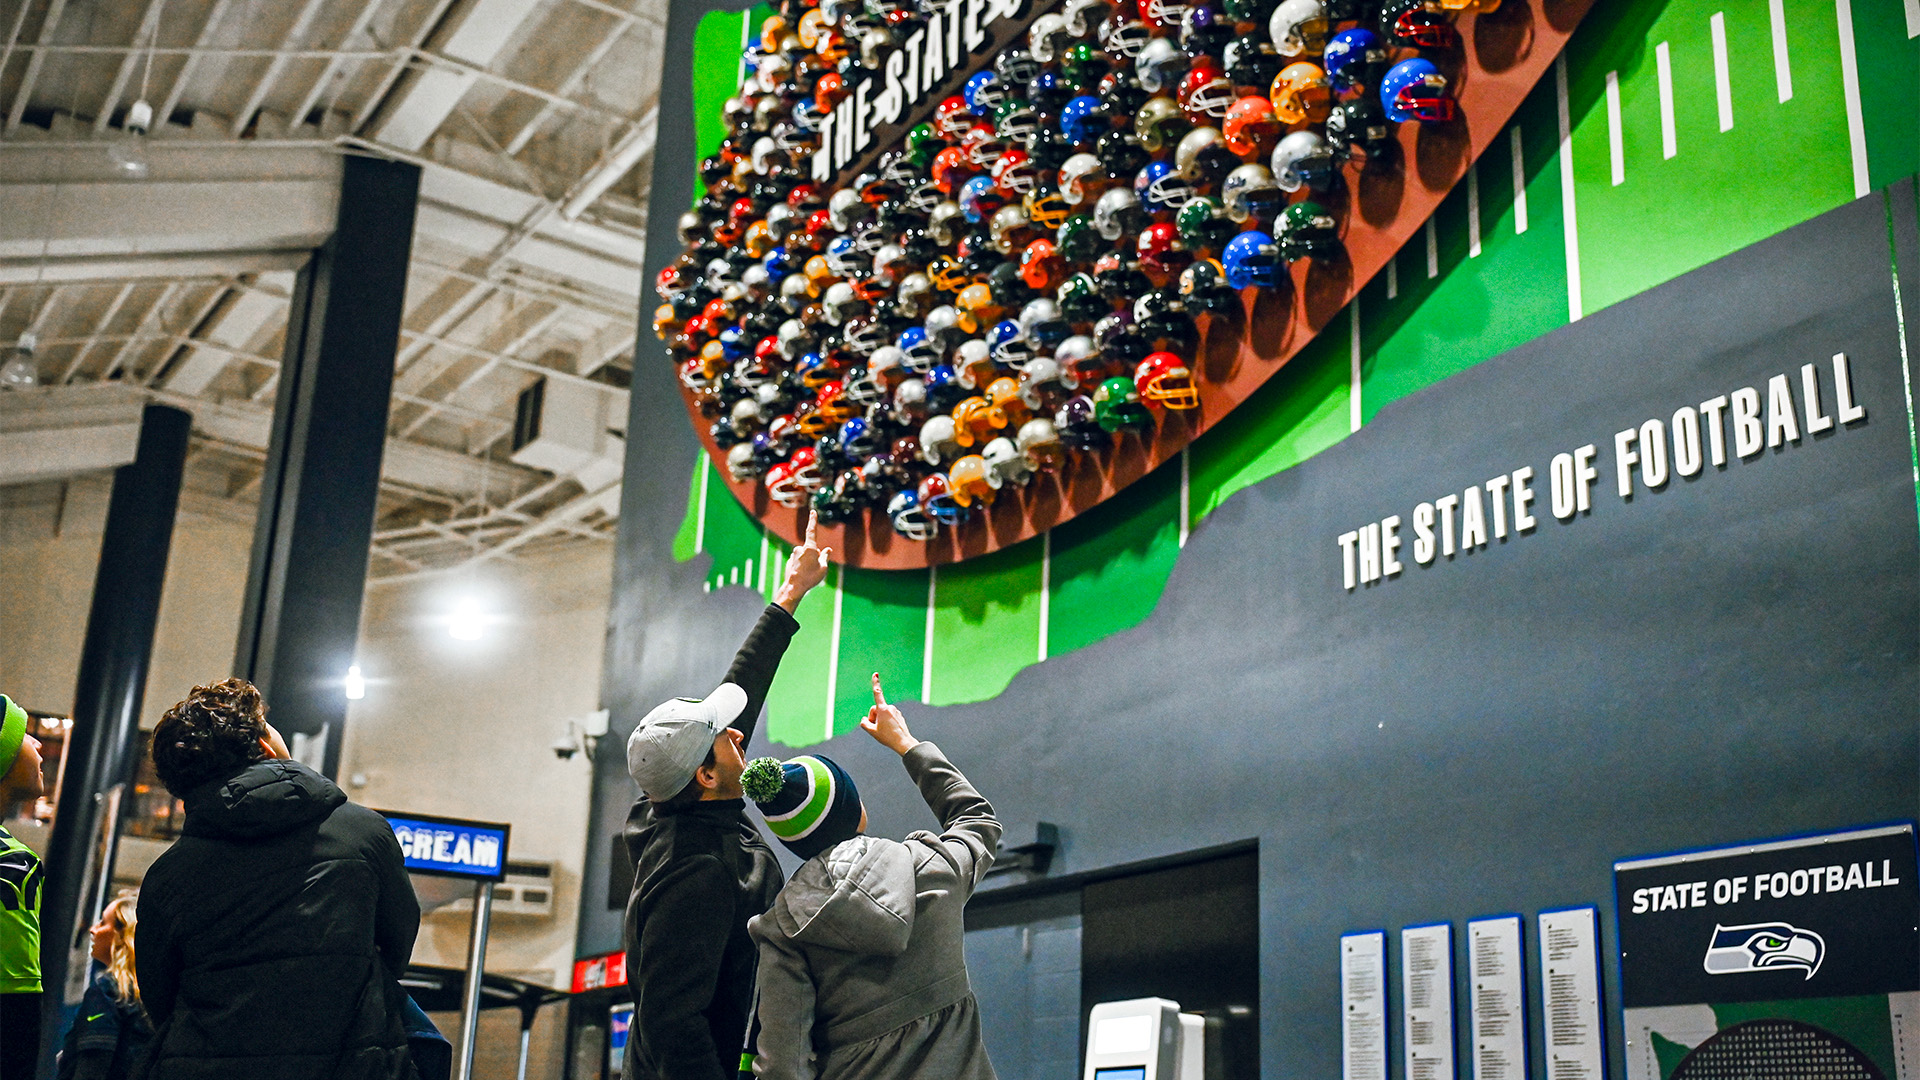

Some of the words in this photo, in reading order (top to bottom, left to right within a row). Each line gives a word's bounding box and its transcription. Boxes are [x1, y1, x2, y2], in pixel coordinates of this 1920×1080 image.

[811, 77, 873, 183] THE
[869, 0, 985, 125] STATE
[1337, 515, 1402, 590] THE
[1412, 465, 1537, 564] STATE
[1550, 443, 1597, 519] OF
[1614, 352, 1866, 497] FOOTBALL
[394, 825, 500, 868] CREAM
[1631, 881, 1708, 914] STATE
[1713, 876, 1748, 905] OF
[1754, 859, 1899, 901] FOOTBALL
